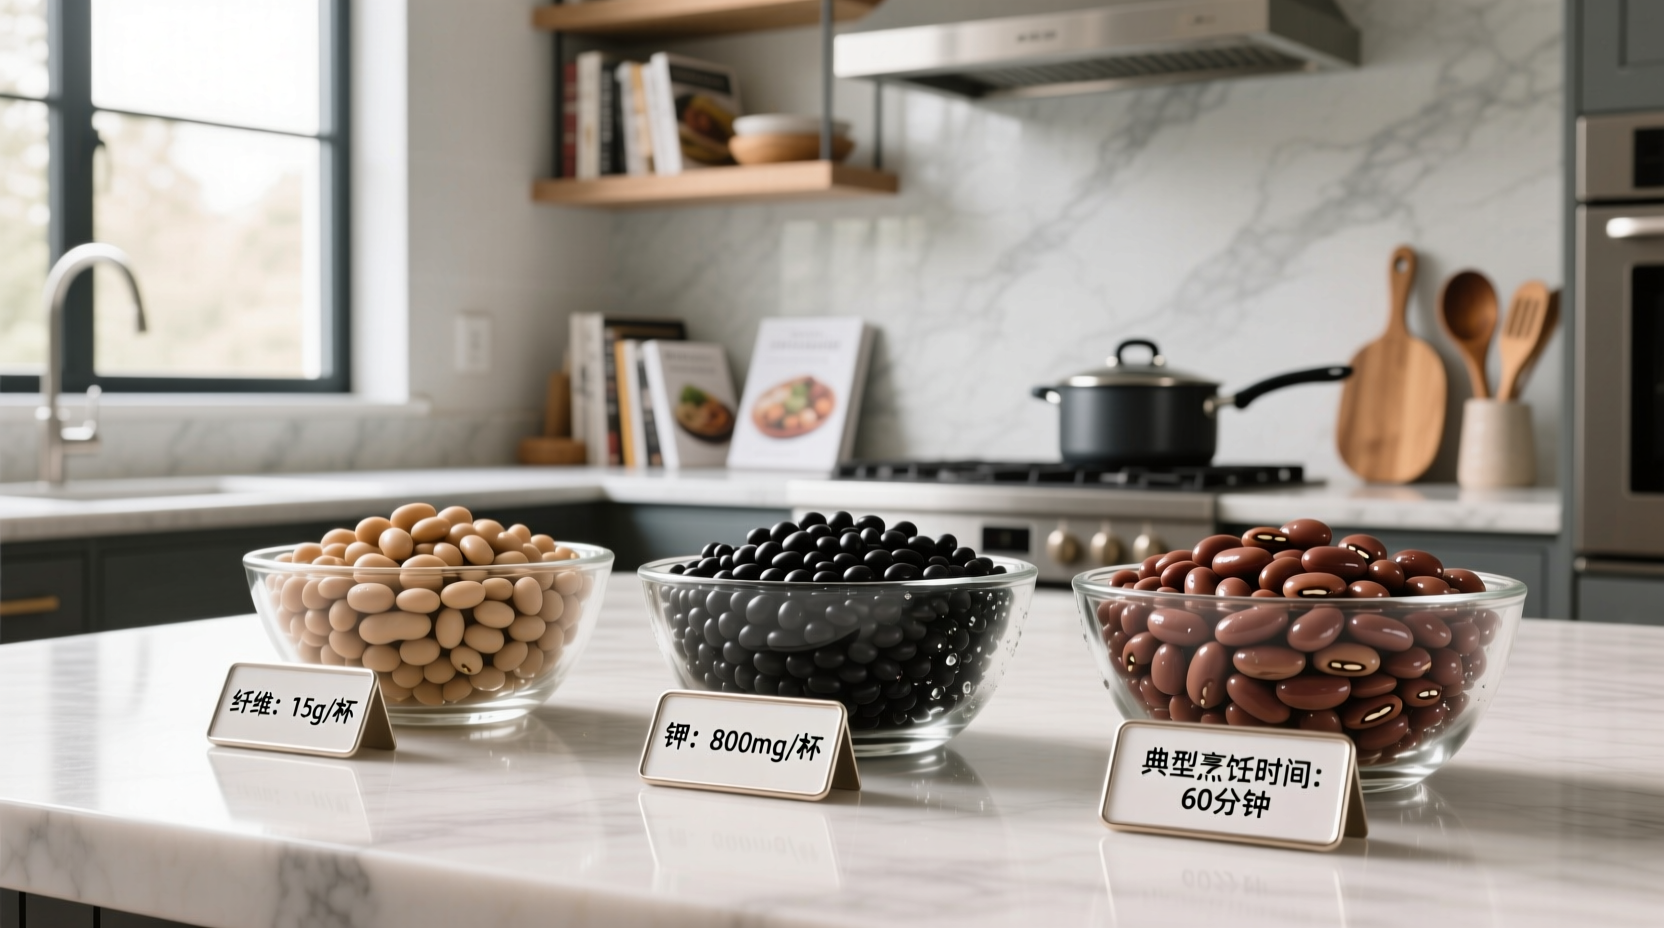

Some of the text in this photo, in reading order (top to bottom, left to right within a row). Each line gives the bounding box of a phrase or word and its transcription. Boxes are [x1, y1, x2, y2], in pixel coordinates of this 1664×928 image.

[1141, 746, 1322, 789] 典型烹饪时间：
[1181, 787, 1271, 819] 60分钟
